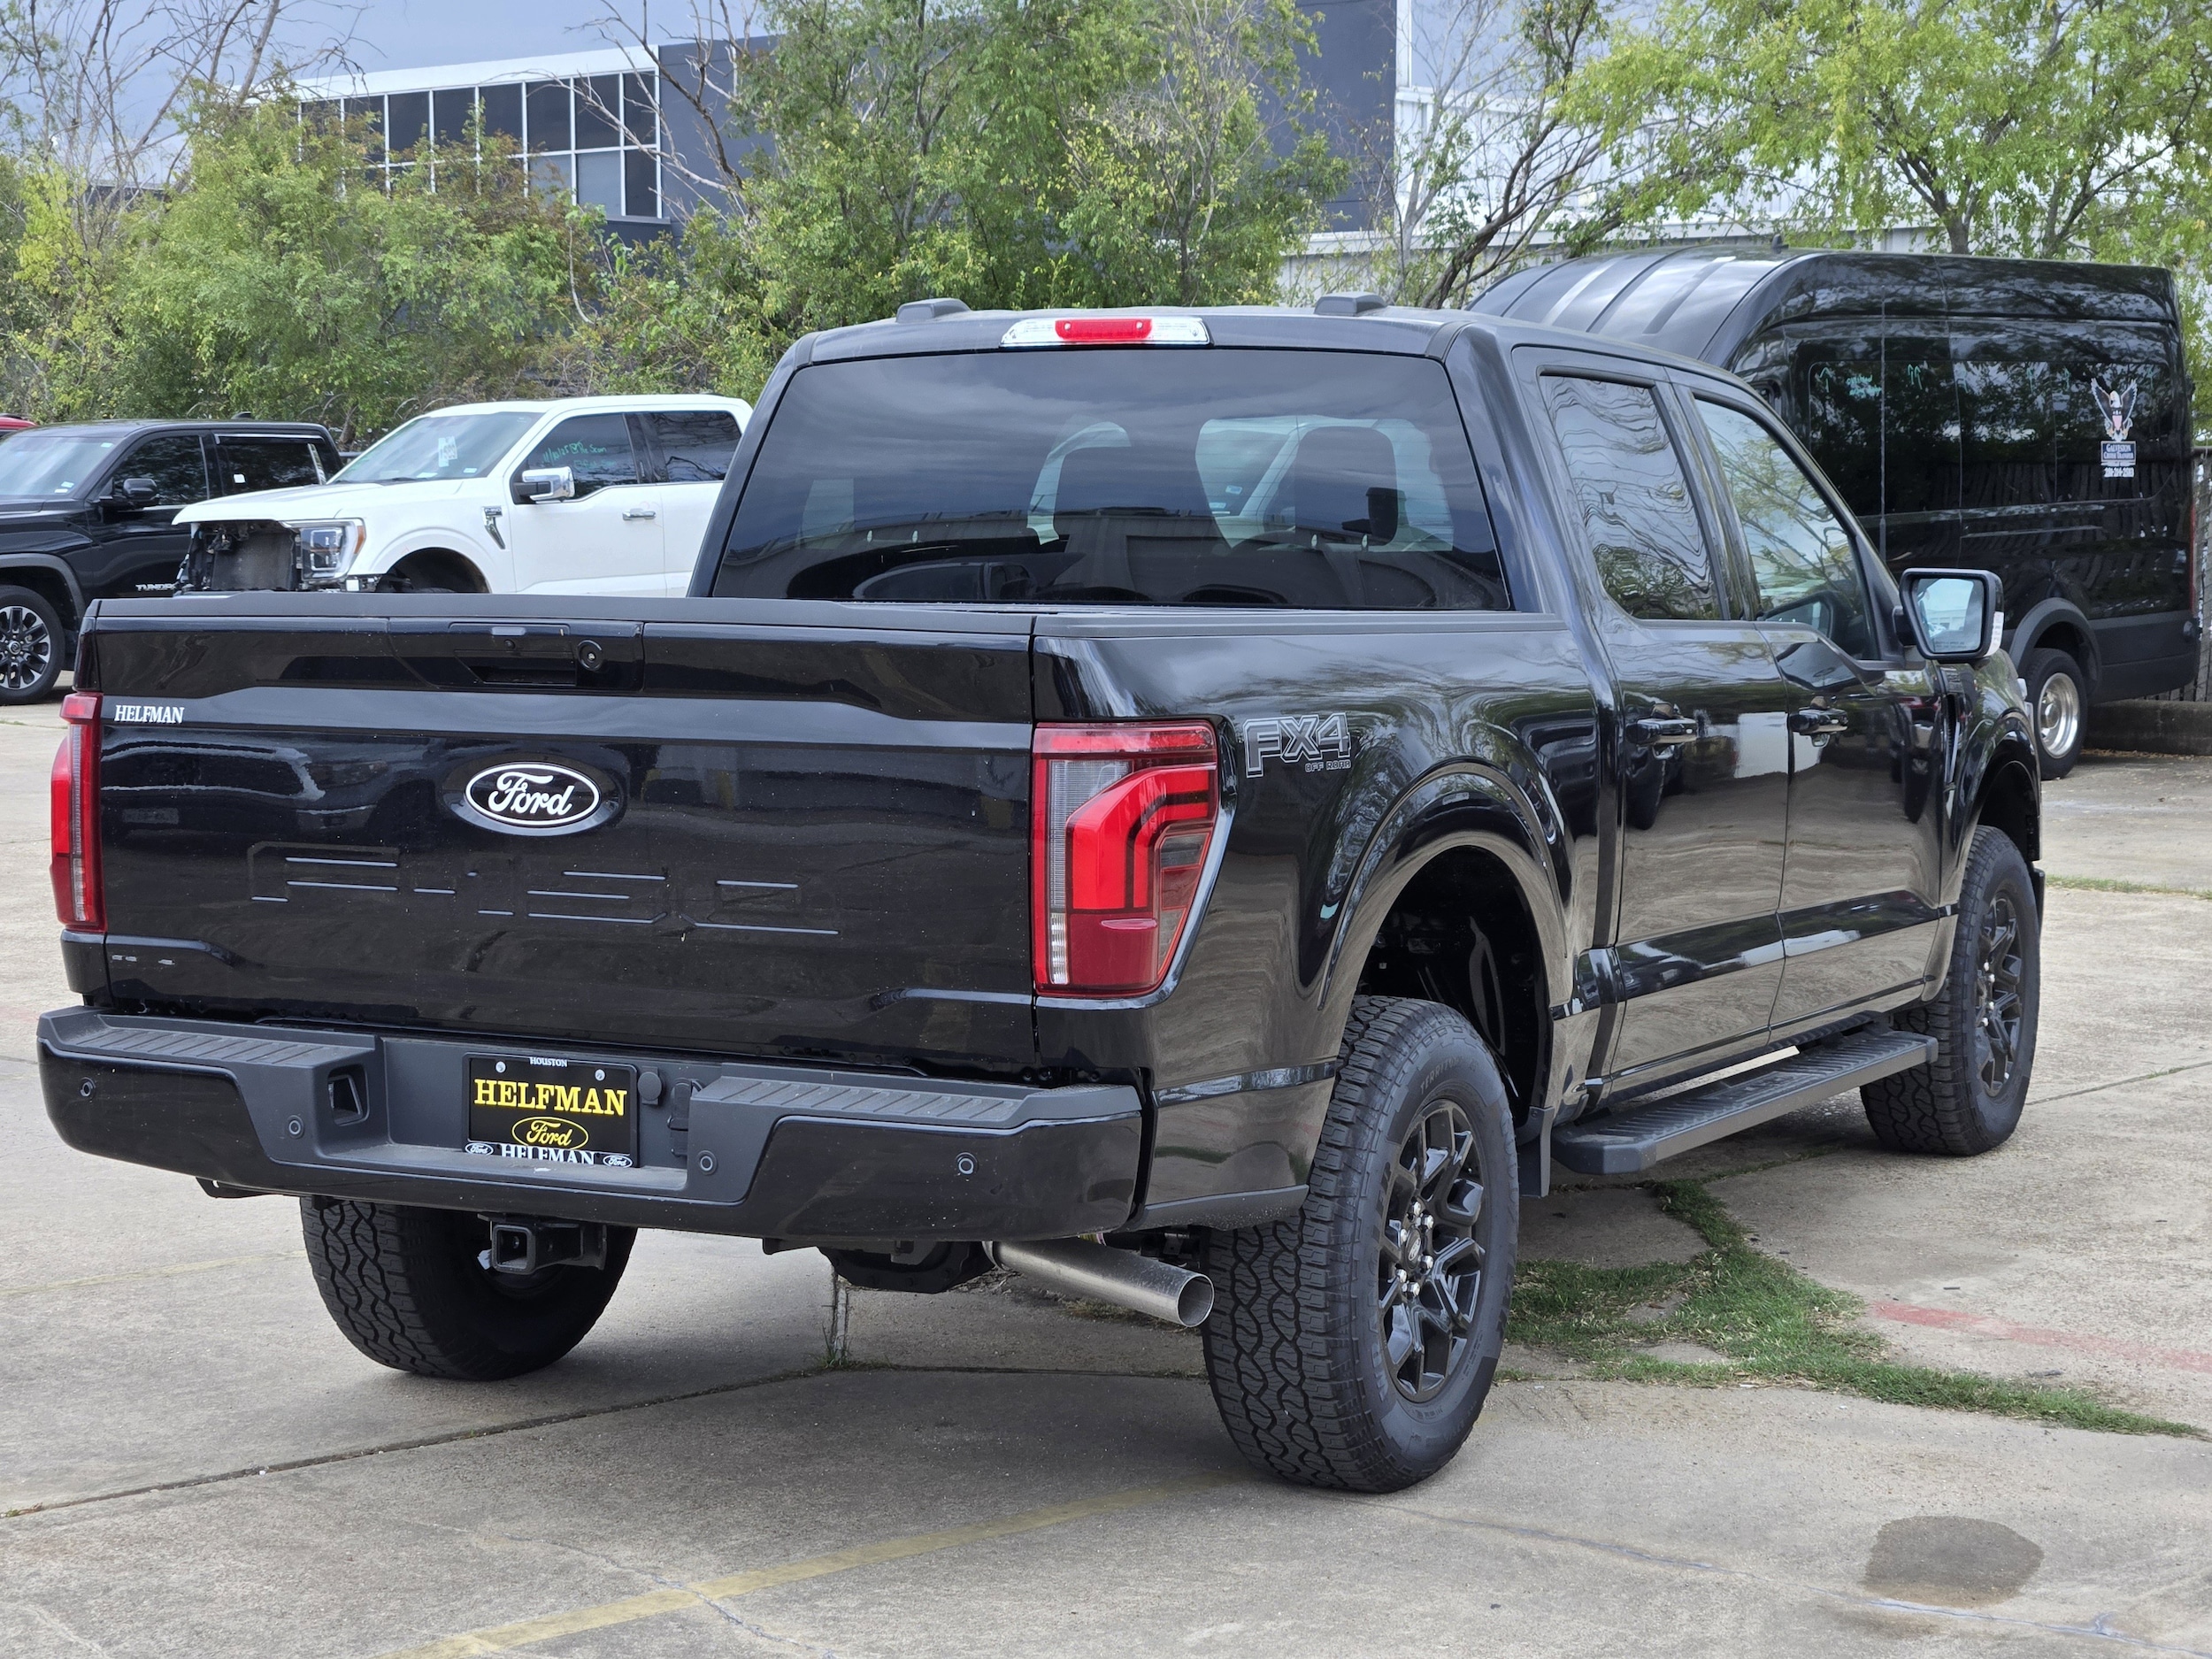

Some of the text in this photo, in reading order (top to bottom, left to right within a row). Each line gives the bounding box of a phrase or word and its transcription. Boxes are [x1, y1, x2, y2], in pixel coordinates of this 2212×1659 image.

[135, 583, 176, 592] TUNDR
[114, 704, 185, 724] HELFMAN
[1243, 712, 1352, 779] FX4
[1305, 759, 1352, 773] OFF ROAD
[488, 772, 575, 816] Ford
[529, 1056, 568, 1068] HOUSTON
[474, 1079, 627, 1117] HELFMAN
[526, 1119, 573, 1147] Ford
